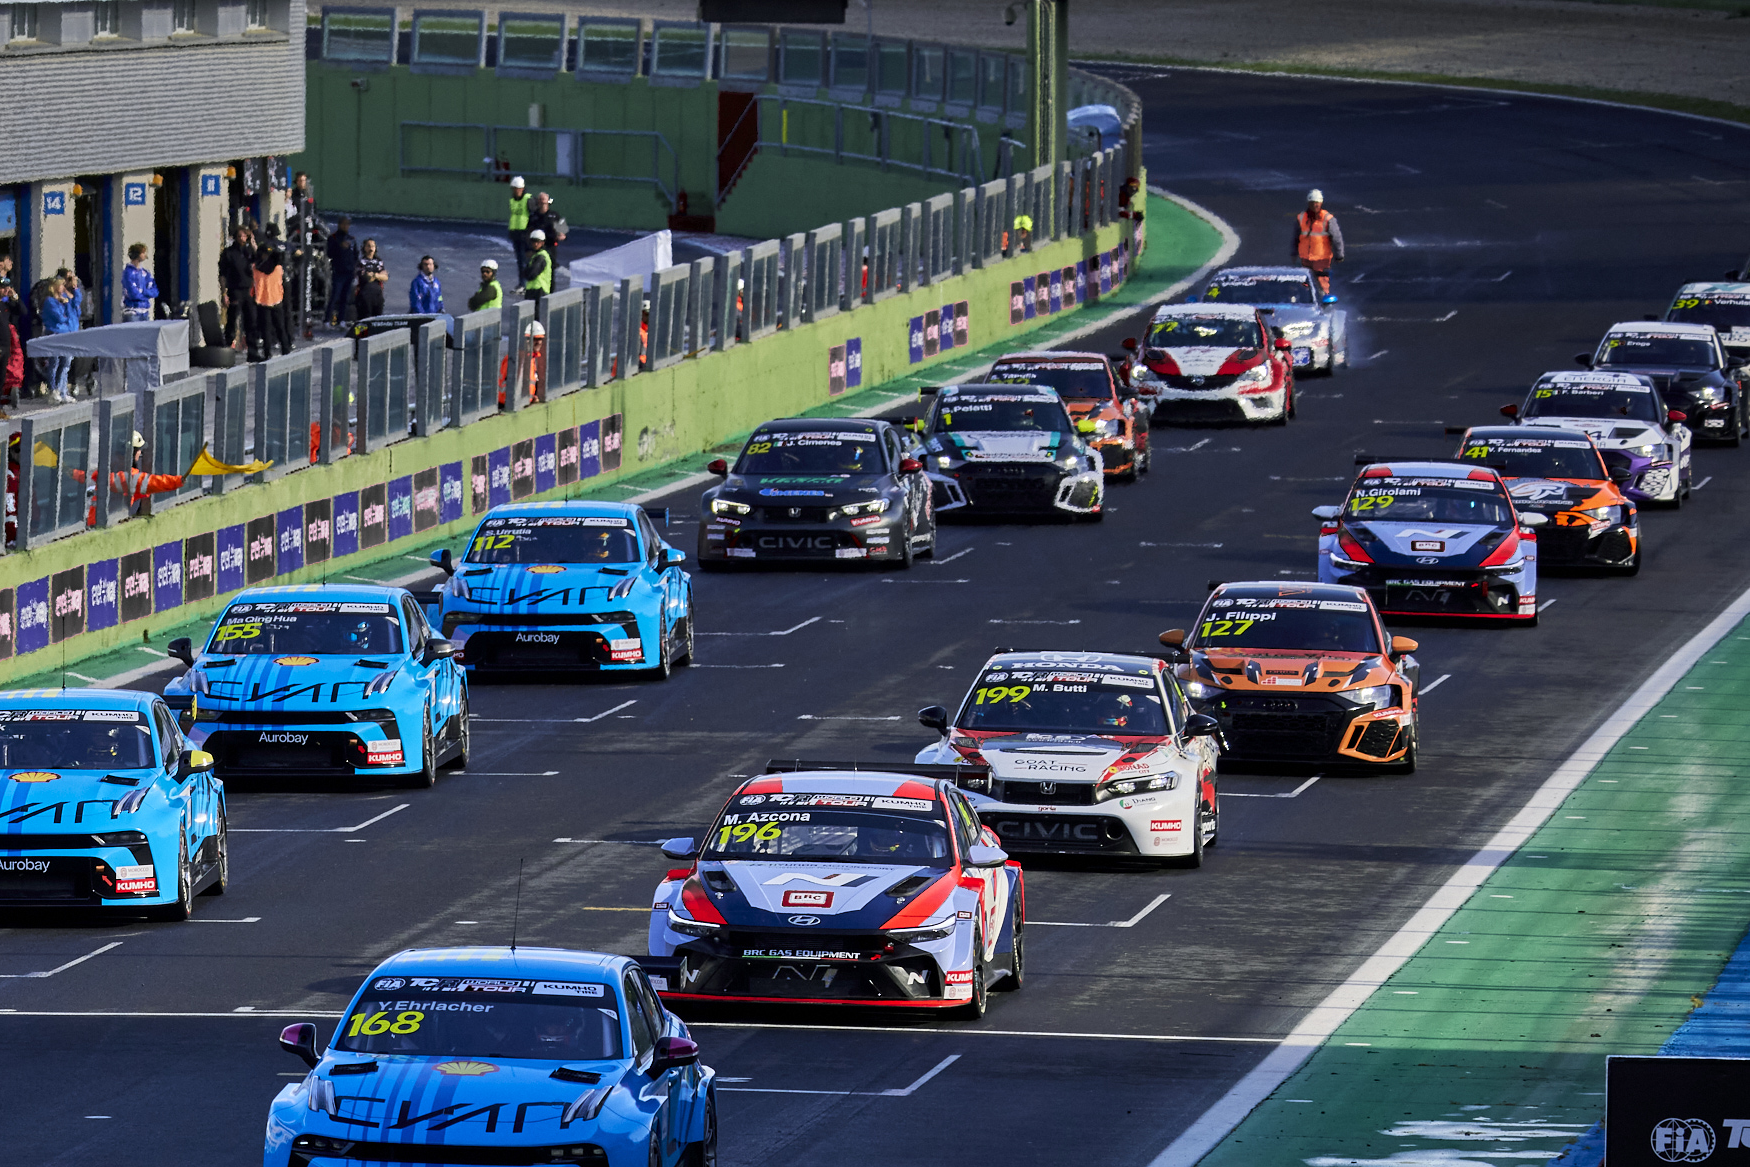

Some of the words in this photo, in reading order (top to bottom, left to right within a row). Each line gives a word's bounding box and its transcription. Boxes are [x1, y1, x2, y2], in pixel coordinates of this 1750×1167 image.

[127, 184, 145, 202] 12
[45, 193, 64, 209] 14
[1672, 299, 1700, 310] 39
[1535, 389, 1553, 398] 15
[942, 413, 952, 426] 1
[747, 443, 772, 454] 82
[1465, 446, 1489, 458] 41
[1355, 488, 1421, 498] N.Girolami
[1351, 496, 1394, 511] 129
[474, 535, 515, 551] 112
[758, 537, 832, 548] CIVIC
[245, 616, 271, 624] Qing
[273, 615, 298, 623] Hua
[1206, 613, 1220, 621] J.
[1225, 612, 1277, 621] Filippi
[215, 622, 263, 642] 155
[1201, 620, 1254, 637] 127
[515, 632, 560, 645] Aurobay
[611, 650, 642, 659] KUMHO
[1011, 662, 1124, 671] HONDA
[1032, 684, 1048, 692] M.
[1052, 684, 1088, 693] Butti
[975, 686, 1031, 705] 199
[259, 732, 309, 746] Aurobay
[368, 753, 403, 763] KUMHO
[1028, 764, 1086, 772] RACING
[723, 814, 742, 825] M.
[746, 812, 811, 823] Azcona
[996, 821, 1098, 839] CIVIC
[1151, 822, 1182, 830] KUMHO
[719, 821, 782, 845] 196
[117, 880, 156, 890] KUMHO
[743, 949, 766, 957] BRC
[768, 949, 793, 957] GAS
[795, 950, 861, 960] EQUIPMENT
[378, 1001, 494, 1013] Y.Ehrlacher
[348, 1011, 425, 1036] 168
